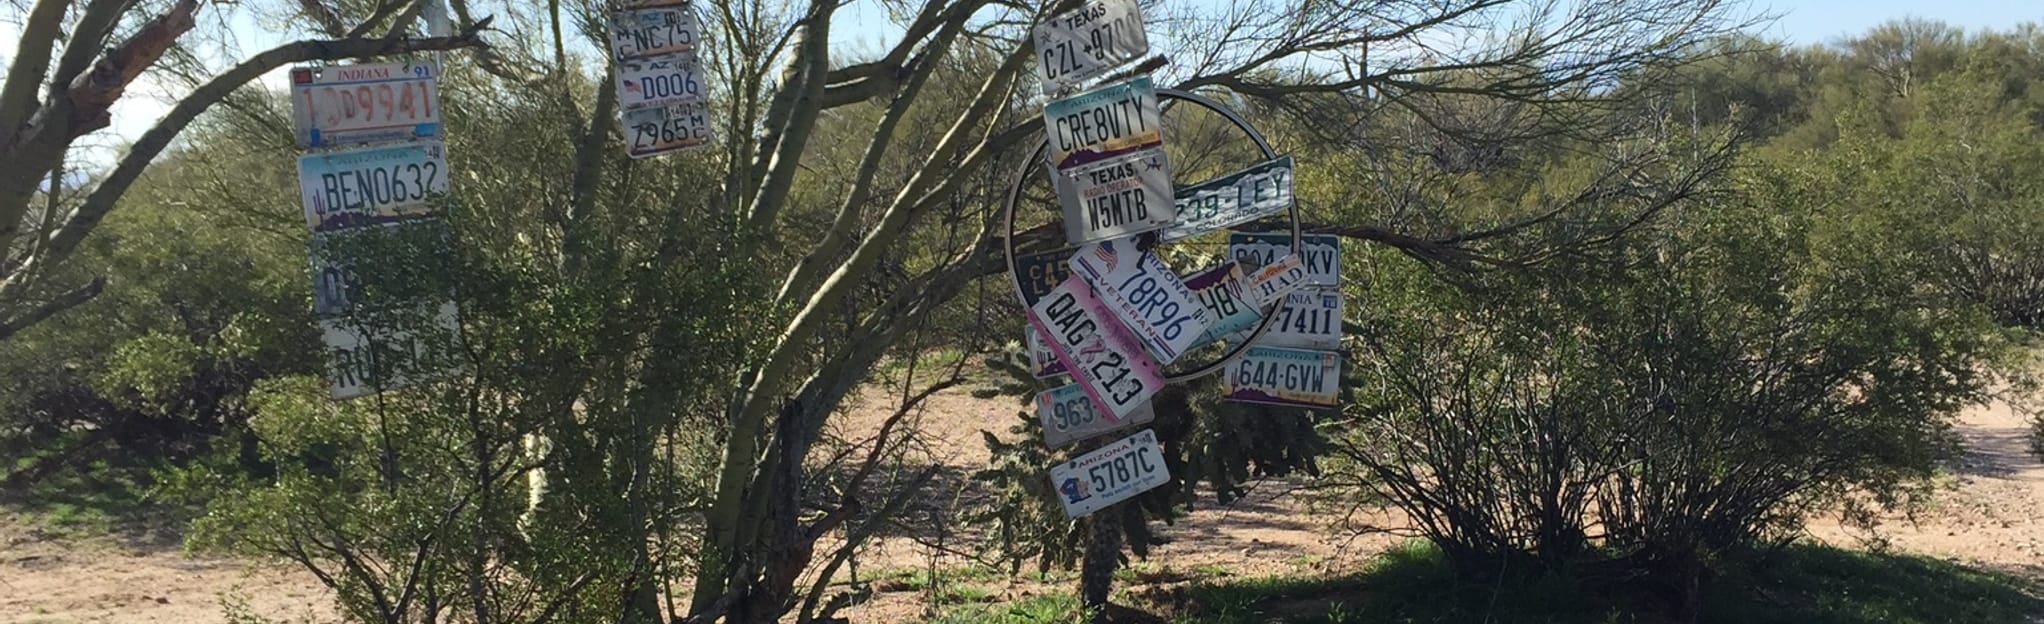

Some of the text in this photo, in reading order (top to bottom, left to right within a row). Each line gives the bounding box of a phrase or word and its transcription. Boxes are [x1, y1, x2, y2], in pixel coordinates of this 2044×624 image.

[1066, 3, 1106, 30] TEXAS
[634, 22, 691, 51] NC75
[337, 67, 390, 81] INDIANA
[414, 66, 430, 77] 91
[649, 61, 671, 70] AZ
[631, 118, 689, 148] Z965
[1056, 95, 1145, 152] CRE8VTY
[1089, 162, 1134, 186] TEXAS
[1195, 206, 1259, 232] COLORADO
[1144, 251, 1189, 300] RIZONA
[1099, 277, 1158, 338] VETERAN
[1118, 266, 1192, 342] 78R96
[1078, 444, 1130, 468] ARIZONA
[1089, 447, 1155, 492] 5787C
